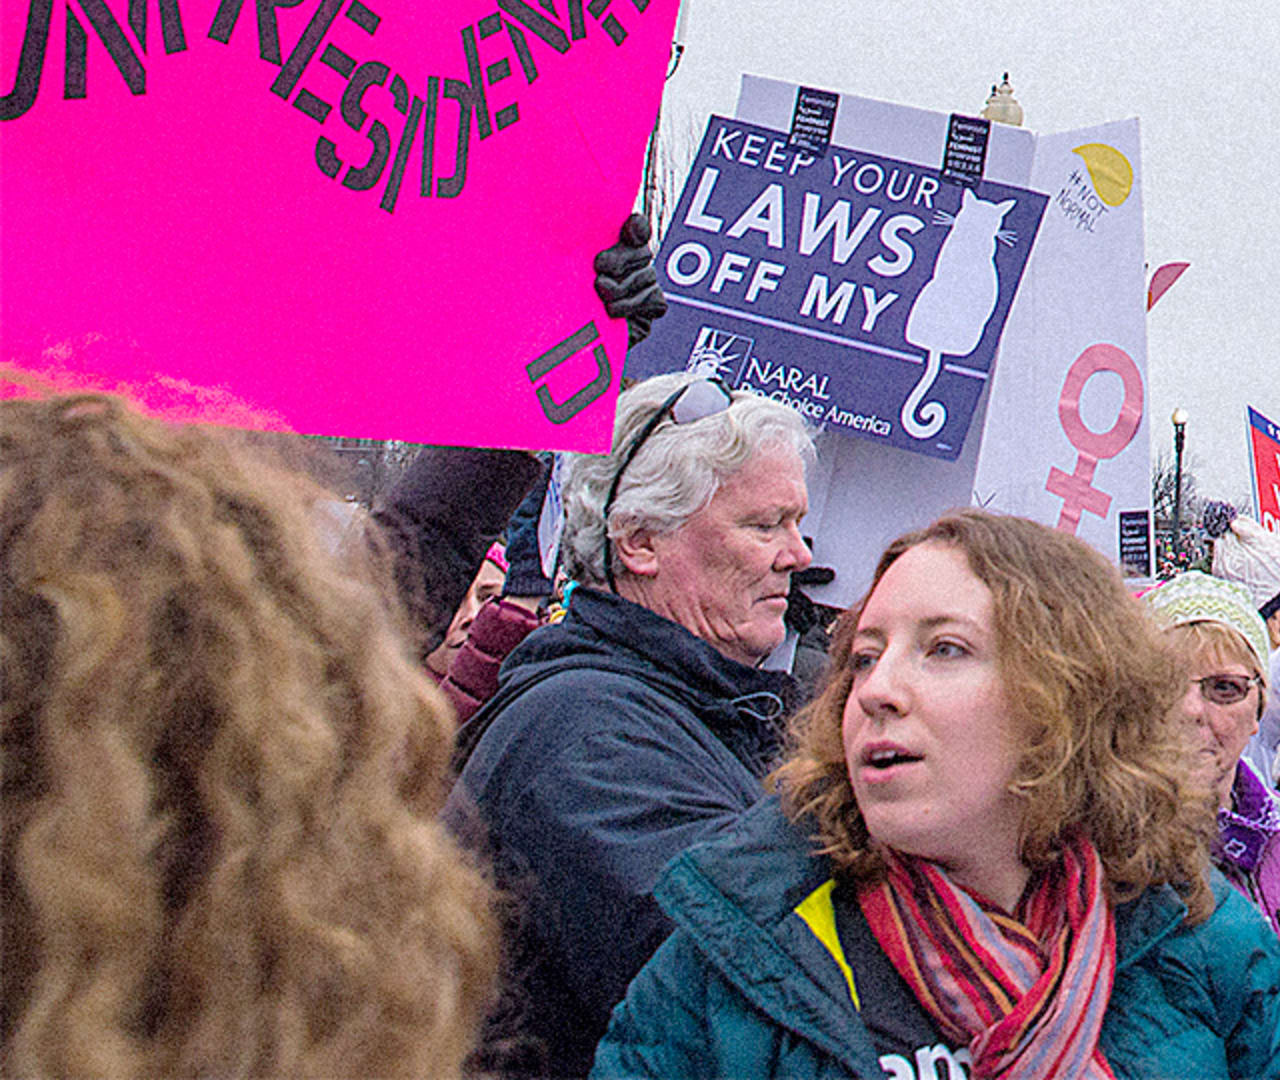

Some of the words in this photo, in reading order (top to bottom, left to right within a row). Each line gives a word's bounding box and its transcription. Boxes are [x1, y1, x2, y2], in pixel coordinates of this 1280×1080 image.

[711, 126, 816, 177] KEEP
[832, 155, 940, 209] YOUR
[1068, 169, 1109, 217] #NOT
[684, 166, 926, 278] LAWS
[665, 241, 787, 304] OFF
[799, 273, 900, 333] MY
[745, 358, 832, 400] NARAL
[824, 404, 892, 437] America
